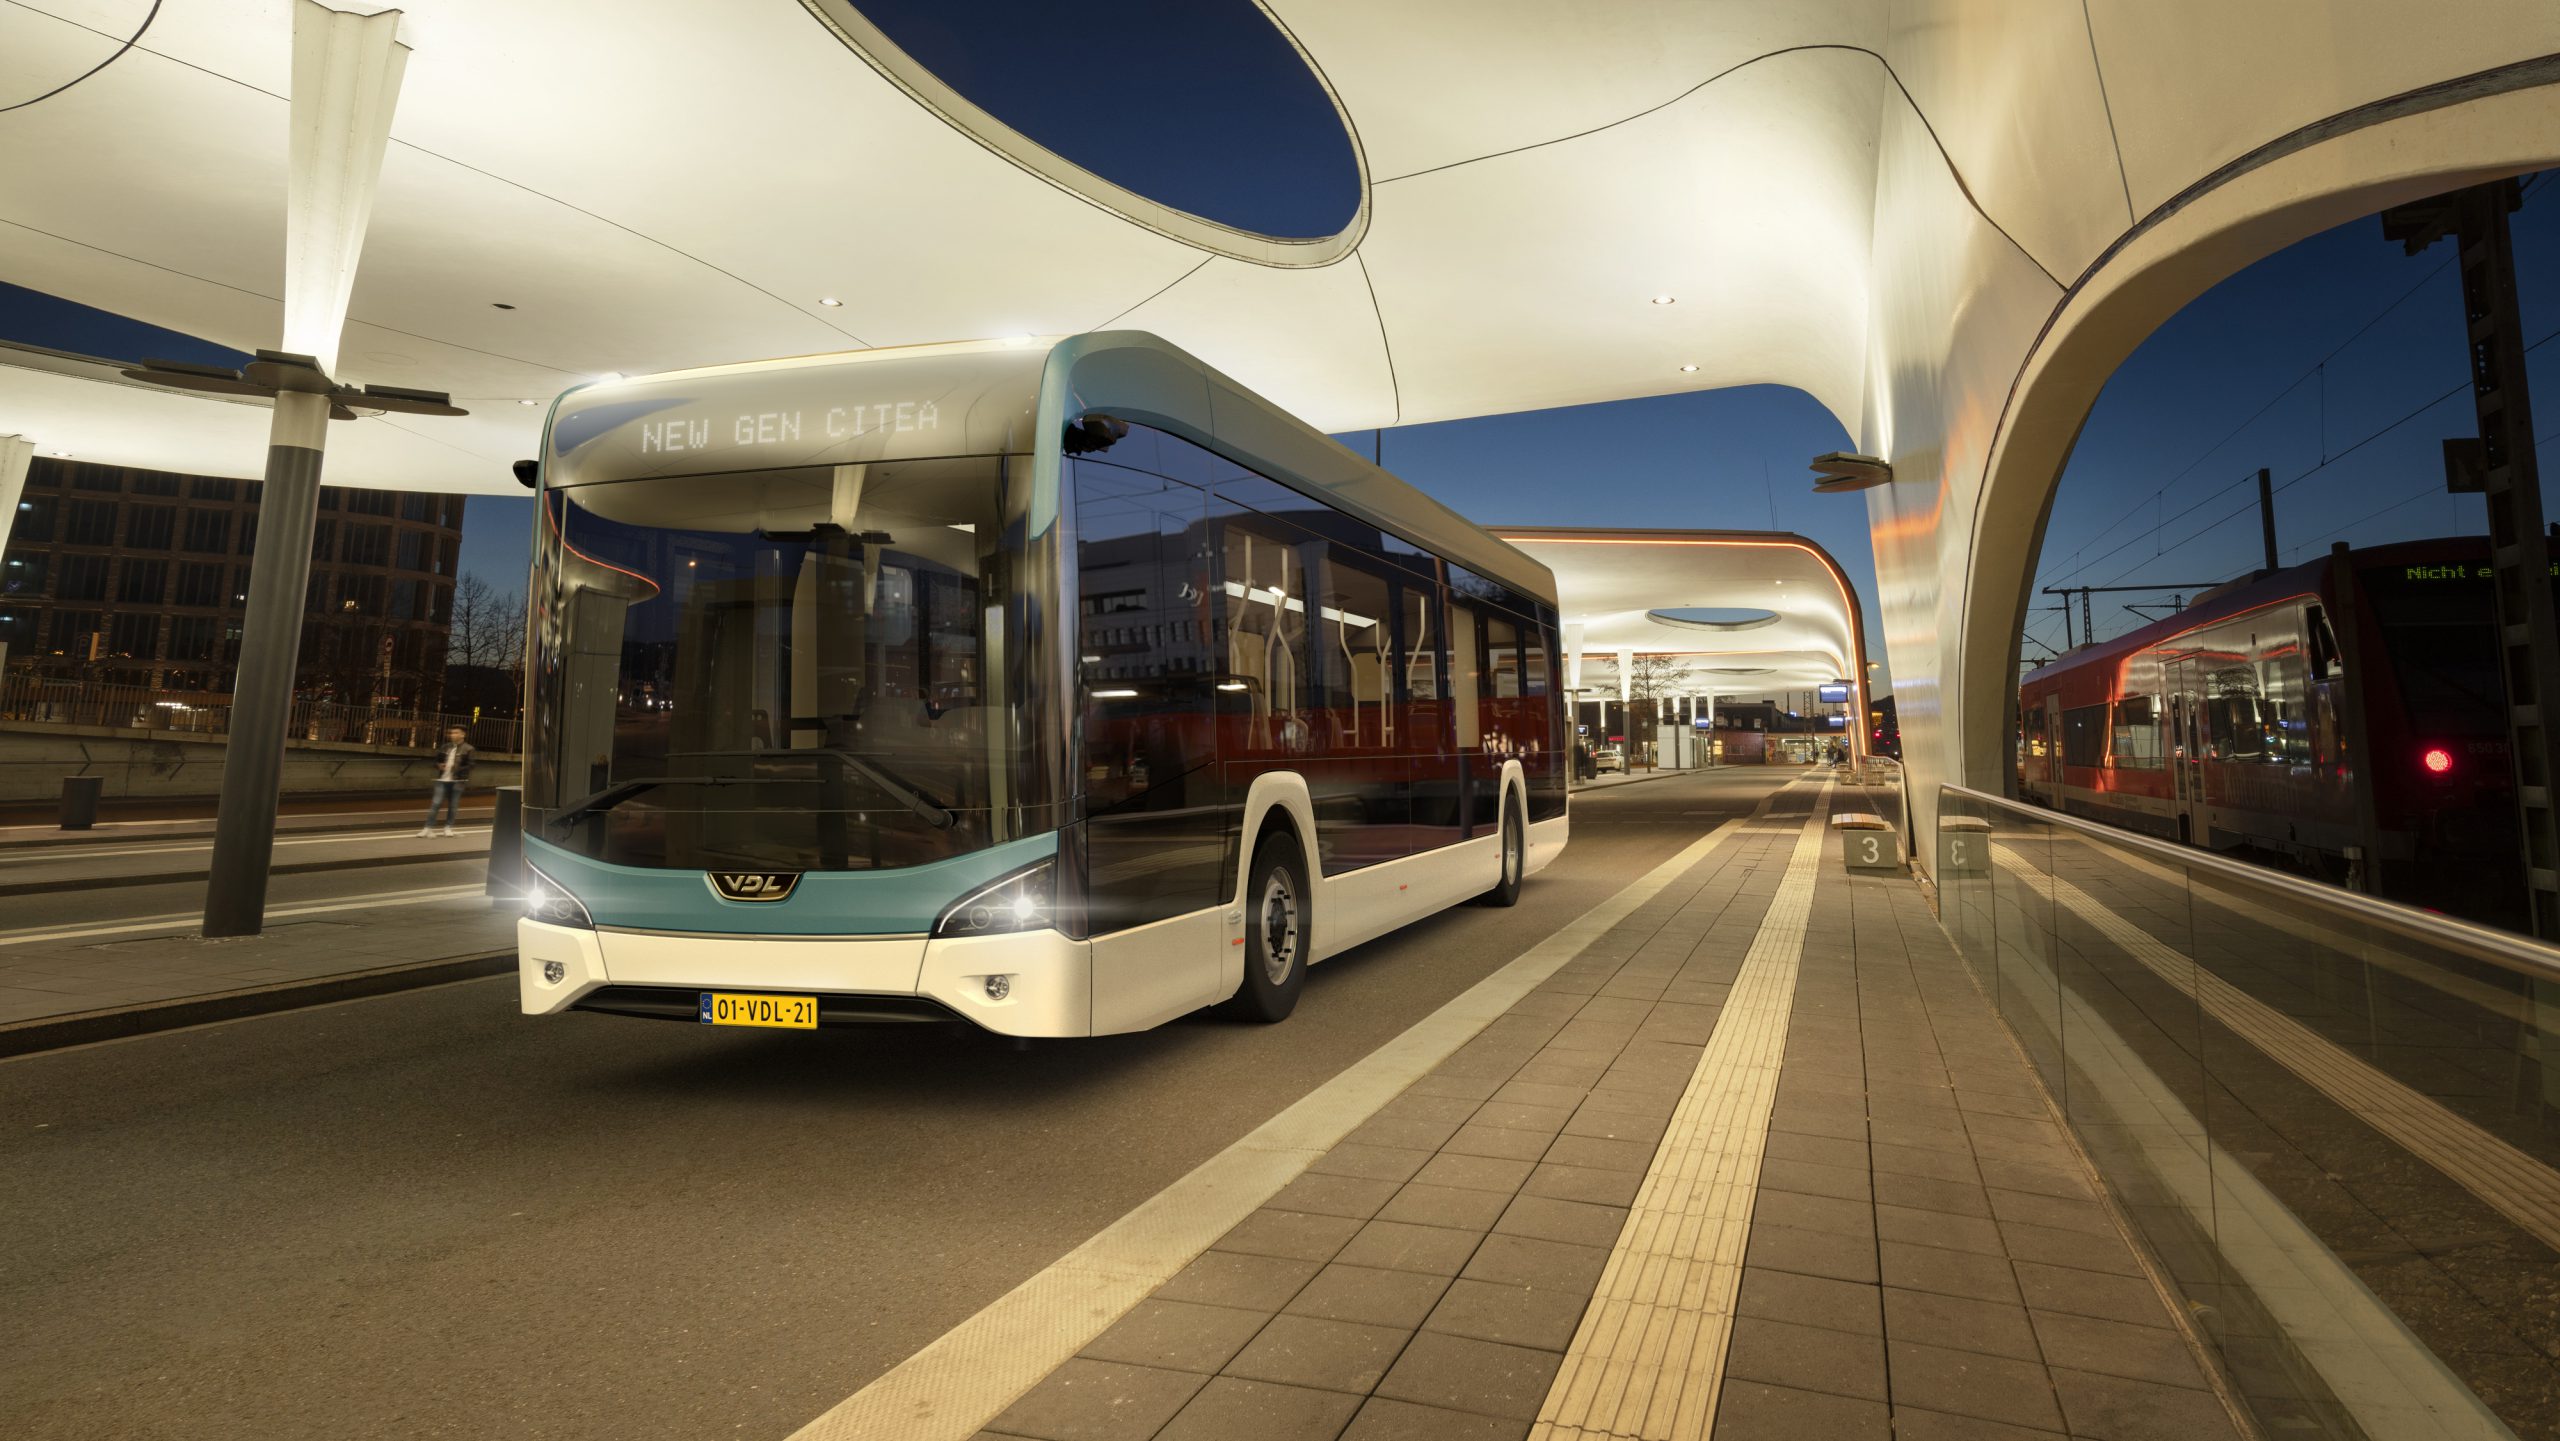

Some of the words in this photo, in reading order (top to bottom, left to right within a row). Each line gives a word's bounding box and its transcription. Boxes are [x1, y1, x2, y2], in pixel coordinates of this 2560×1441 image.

[643, 420, 709, 453] NEW
[735, 411, 800, 445] GEN
[827, 400, 938, 437] CITEA
[2407, 565, 2466, 579] Nicht
[1845, 774, 1852, 784] 2
[1862, 836, 1880, 864] 3
[724, 875, 782, 893] VDL
[702, 1011, 713, 1020] NL
[717, 999, 813, 1024] 01-VDL-21
